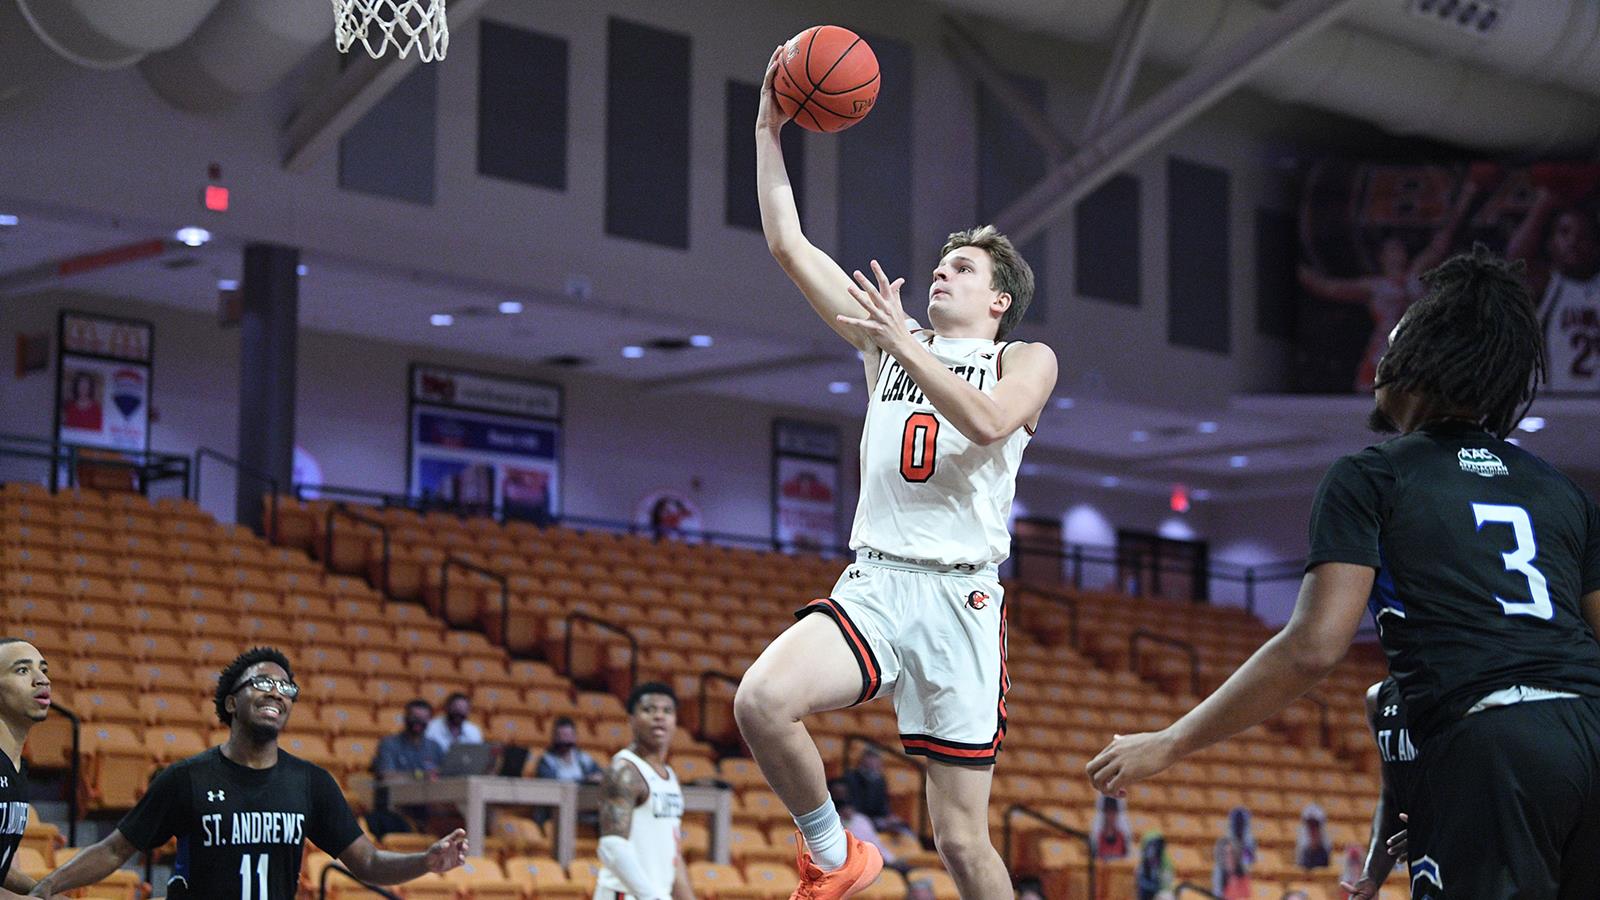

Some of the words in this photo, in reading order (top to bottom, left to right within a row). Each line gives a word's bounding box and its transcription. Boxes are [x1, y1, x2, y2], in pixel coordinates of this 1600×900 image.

[900, 412, 940, 483] 0
[1461, 447, 1493, 460] AAC
[1470, 502, 1555, 620] 3
[202, 813, 227, 847] ST.
[231, 811, 305, 845] ANDREWS
[240, 853, 269, 900] 11
